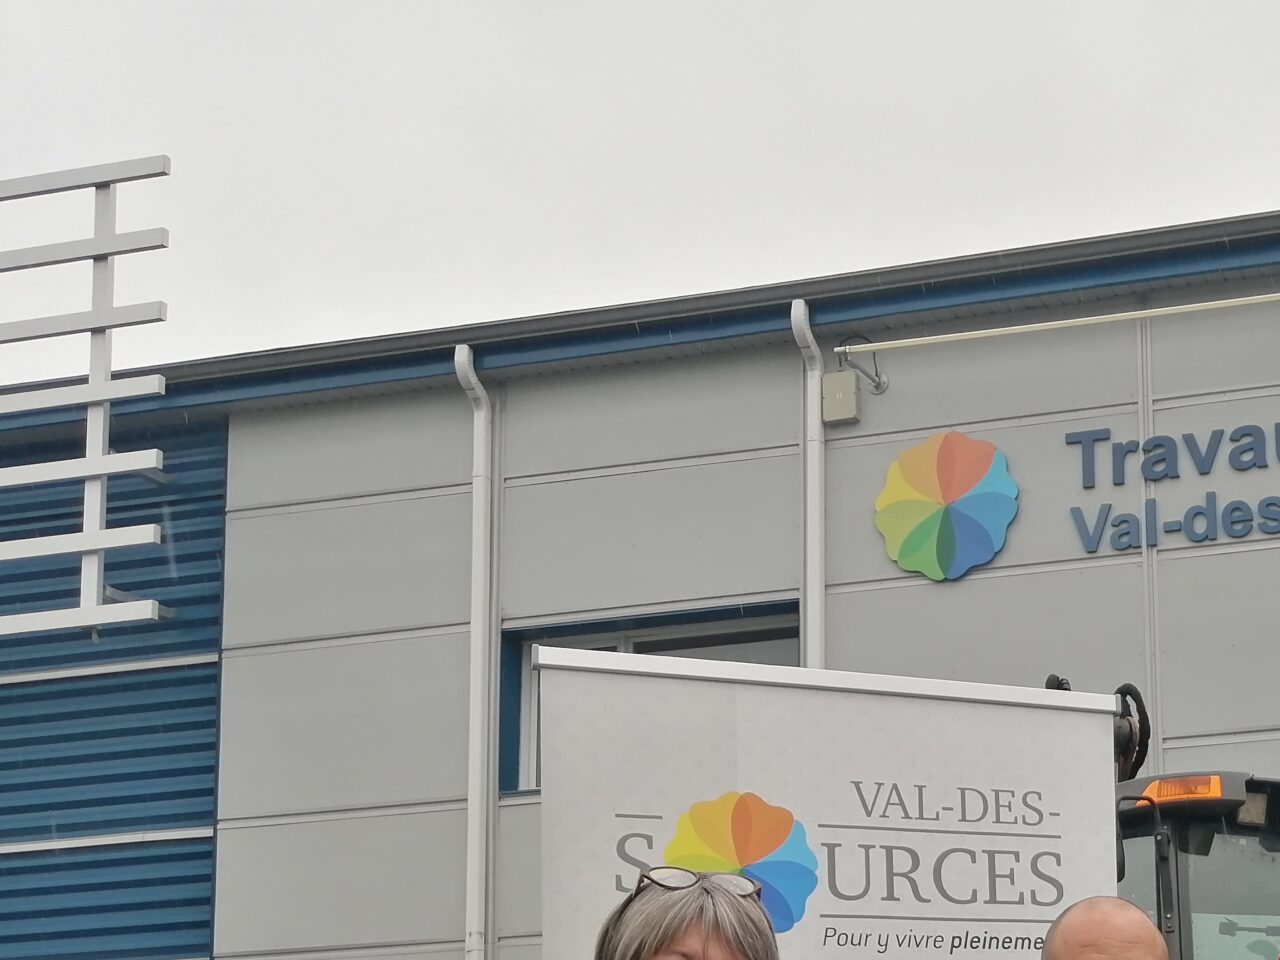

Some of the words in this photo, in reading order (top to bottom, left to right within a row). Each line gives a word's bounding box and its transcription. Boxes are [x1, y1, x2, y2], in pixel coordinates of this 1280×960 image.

[850, 781, 1061, 827] VAL-DES-
[823, 927, 872, 948] Pour
[877, 933, 890, 954] y
[895, 929, 945, 950] vivre
[950, 931, 1044, 956] pleineme
